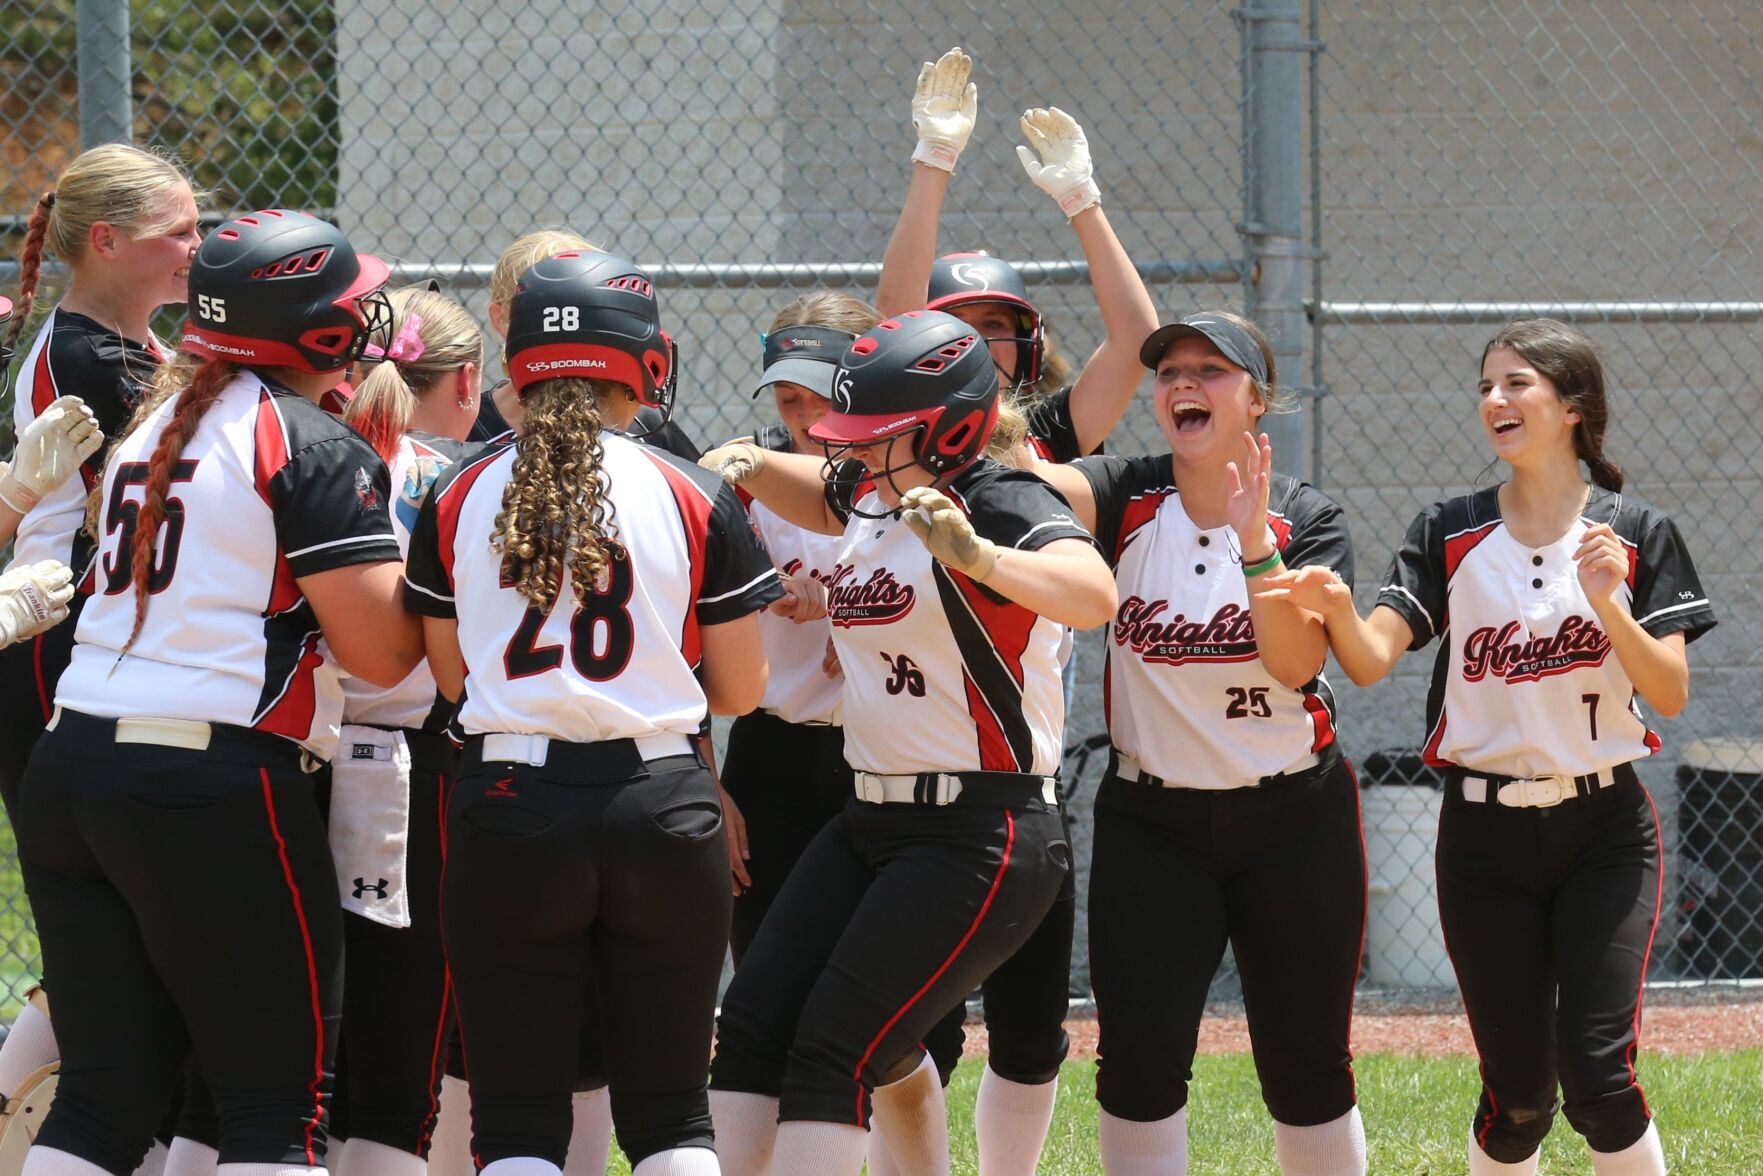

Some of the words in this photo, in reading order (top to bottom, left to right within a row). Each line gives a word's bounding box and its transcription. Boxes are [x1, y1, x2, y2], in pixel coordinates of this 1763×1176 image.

[198, 293, 227, 323] 55
[543, 306, 580, 332] 28
[208, 343, 255, 357] BOOMBAH
[550, 359, 606, 369] BOOMBAH
[102, 459, 200, 596] 55
[499, 537, 635, 683] 28
[838, 608, 870, 617] SOFTBALL
[1159, 645, 1227, 655] SOFTBALL
[1463, 615, 1611, 682] Knights
[1521, 655, 1572, 672] SOFTBALL
[1225, 687, 1273, 720] 25
[1581, 693, 1601, 741] 7
